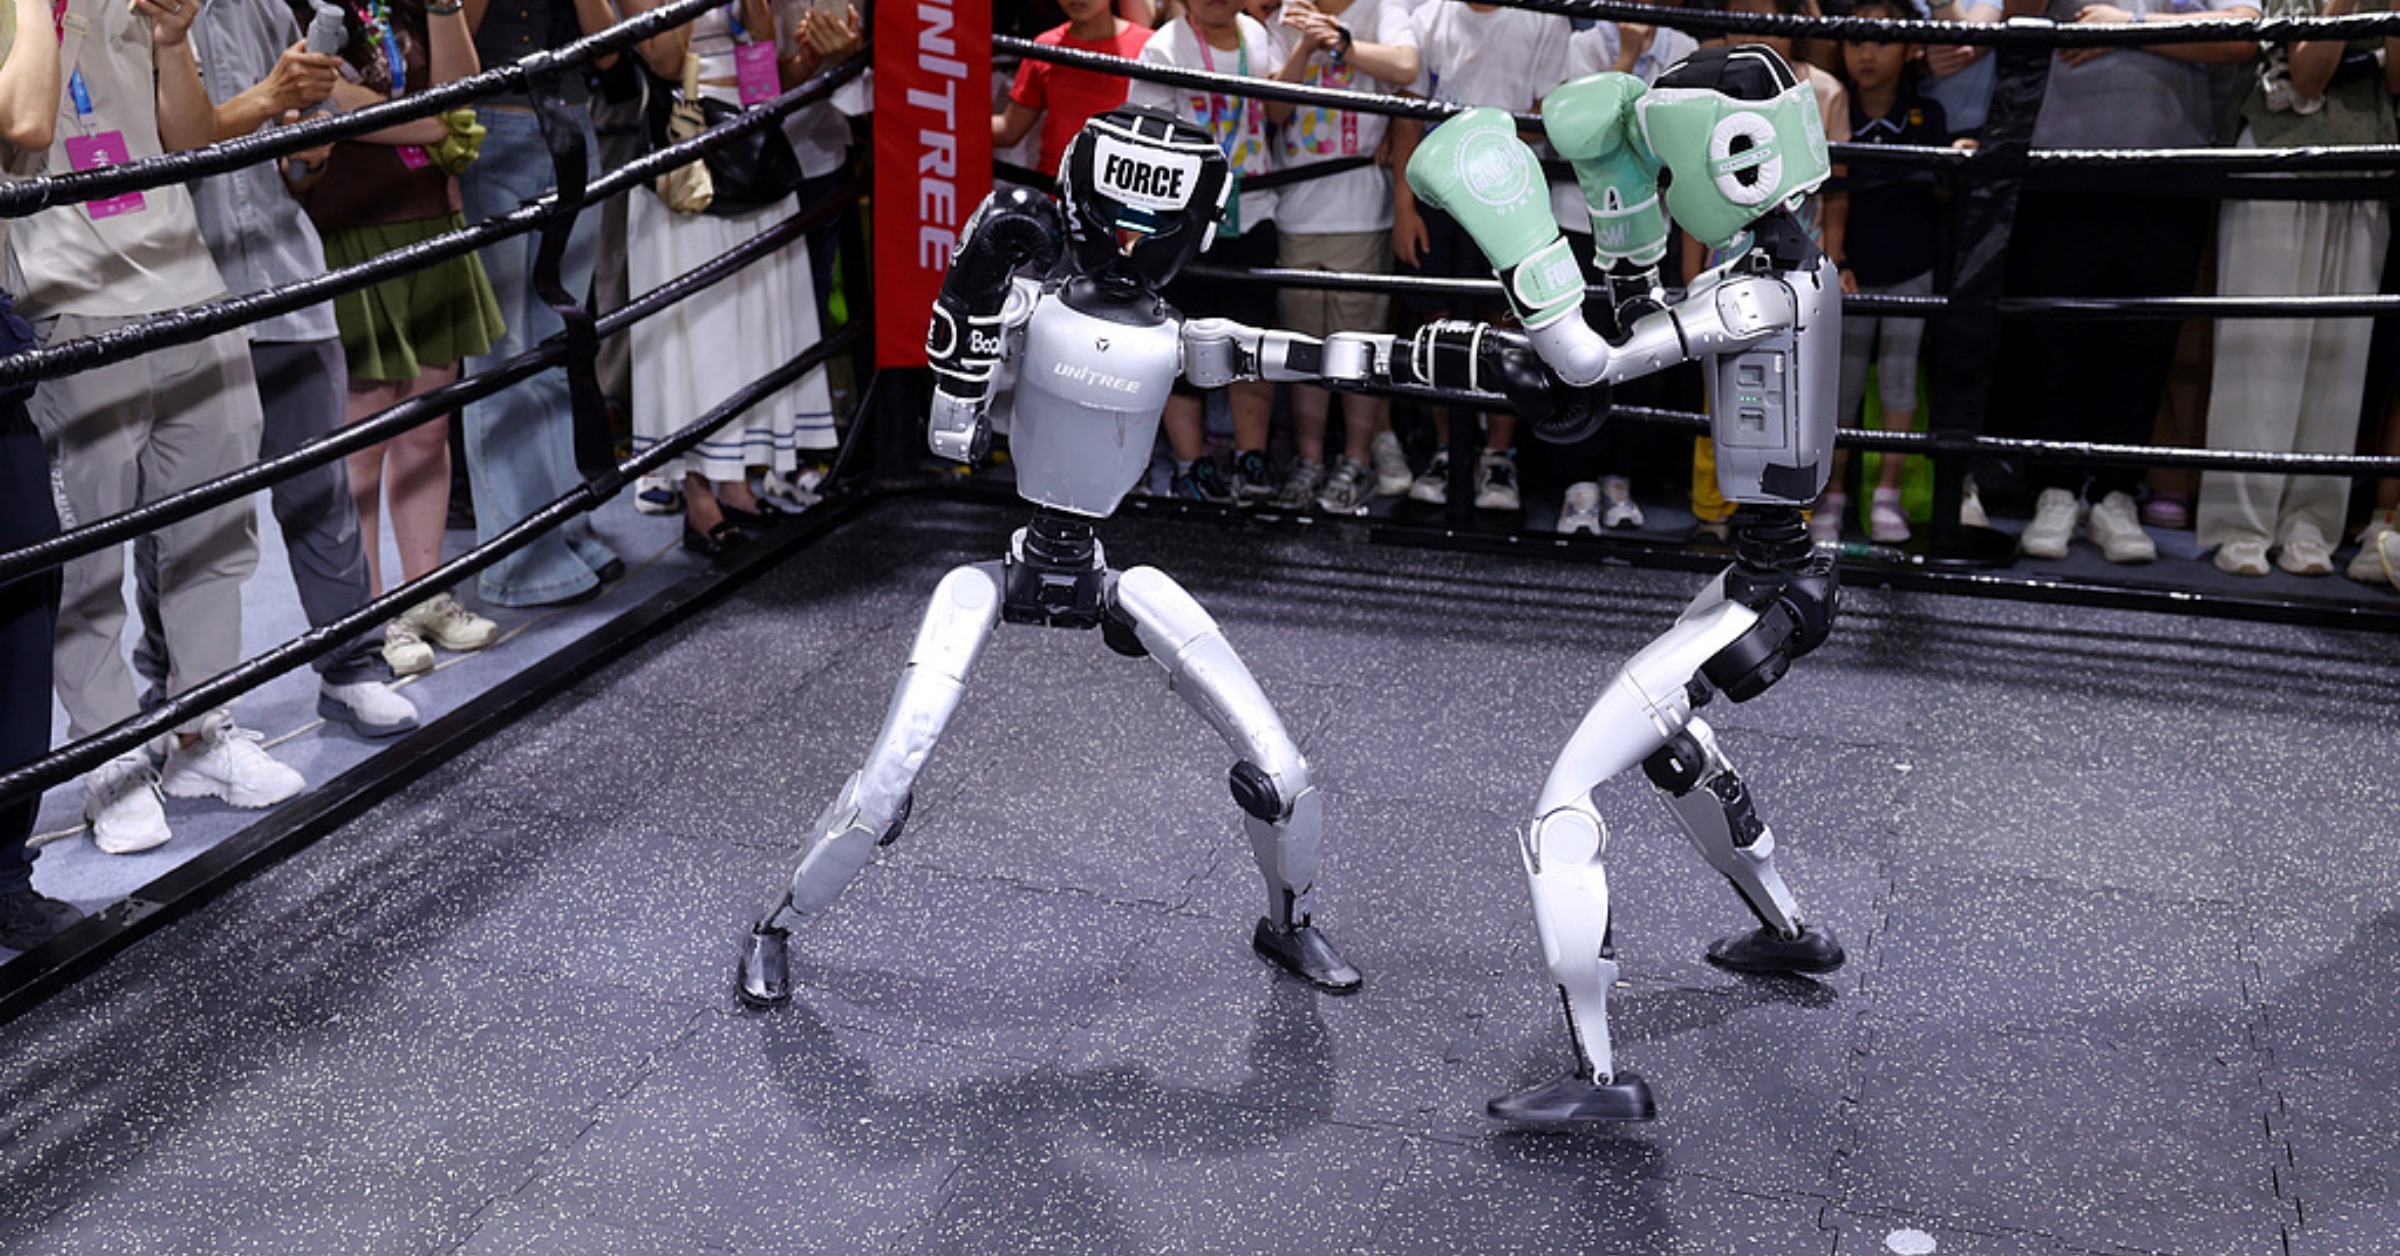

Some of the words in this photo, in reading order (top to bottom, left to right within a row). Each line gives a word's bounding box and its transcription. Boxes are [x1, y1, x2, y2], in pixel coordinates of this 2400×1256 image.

[907, 0, 968, 271] NITREE
[1103, 153, 1184, 199] FORCE
[970, 329, 1001, 354] Boo
[1053, 361, 1142, 394] UNITREE
